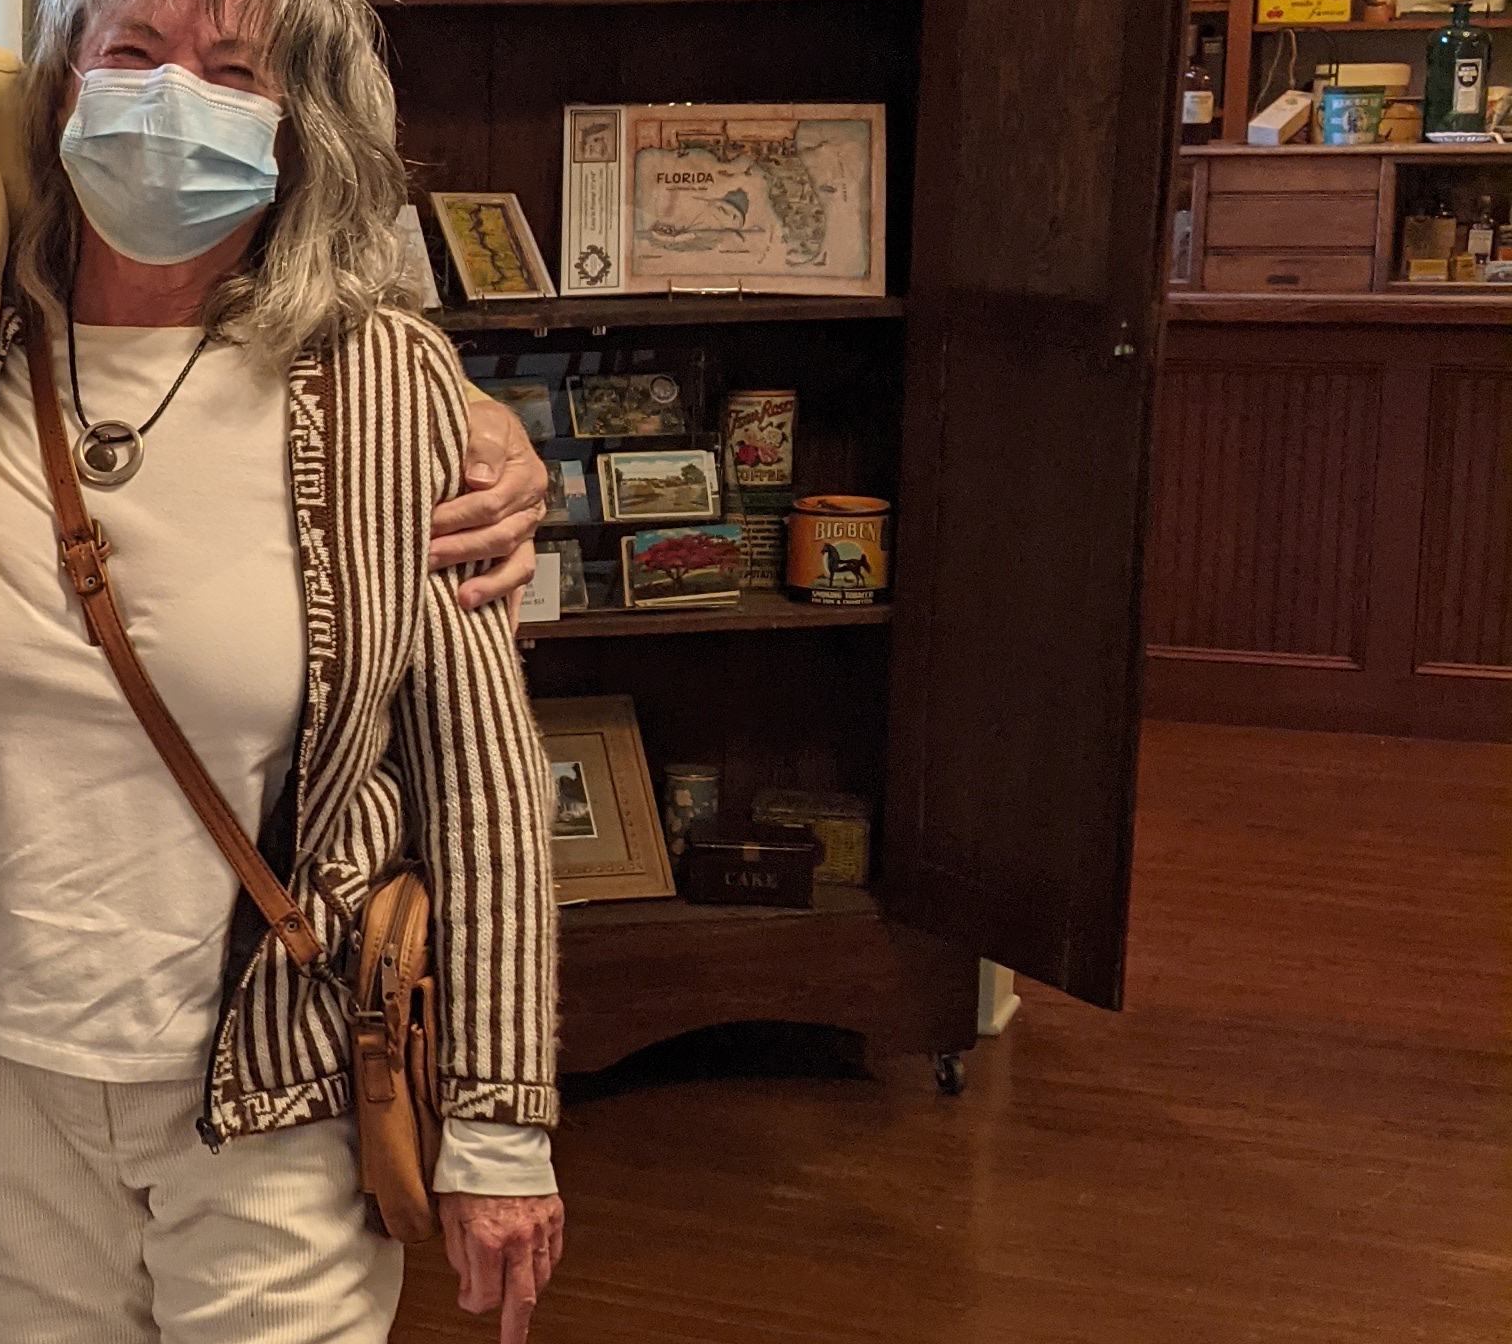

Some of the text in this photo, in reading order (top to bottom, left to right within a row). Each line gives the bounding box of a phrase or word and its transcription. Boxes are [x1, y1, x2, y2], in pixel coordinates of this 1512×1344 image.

[656, 172, 714, 184] FLORIDA
[815, 521, 876, 542] BIG BEN
